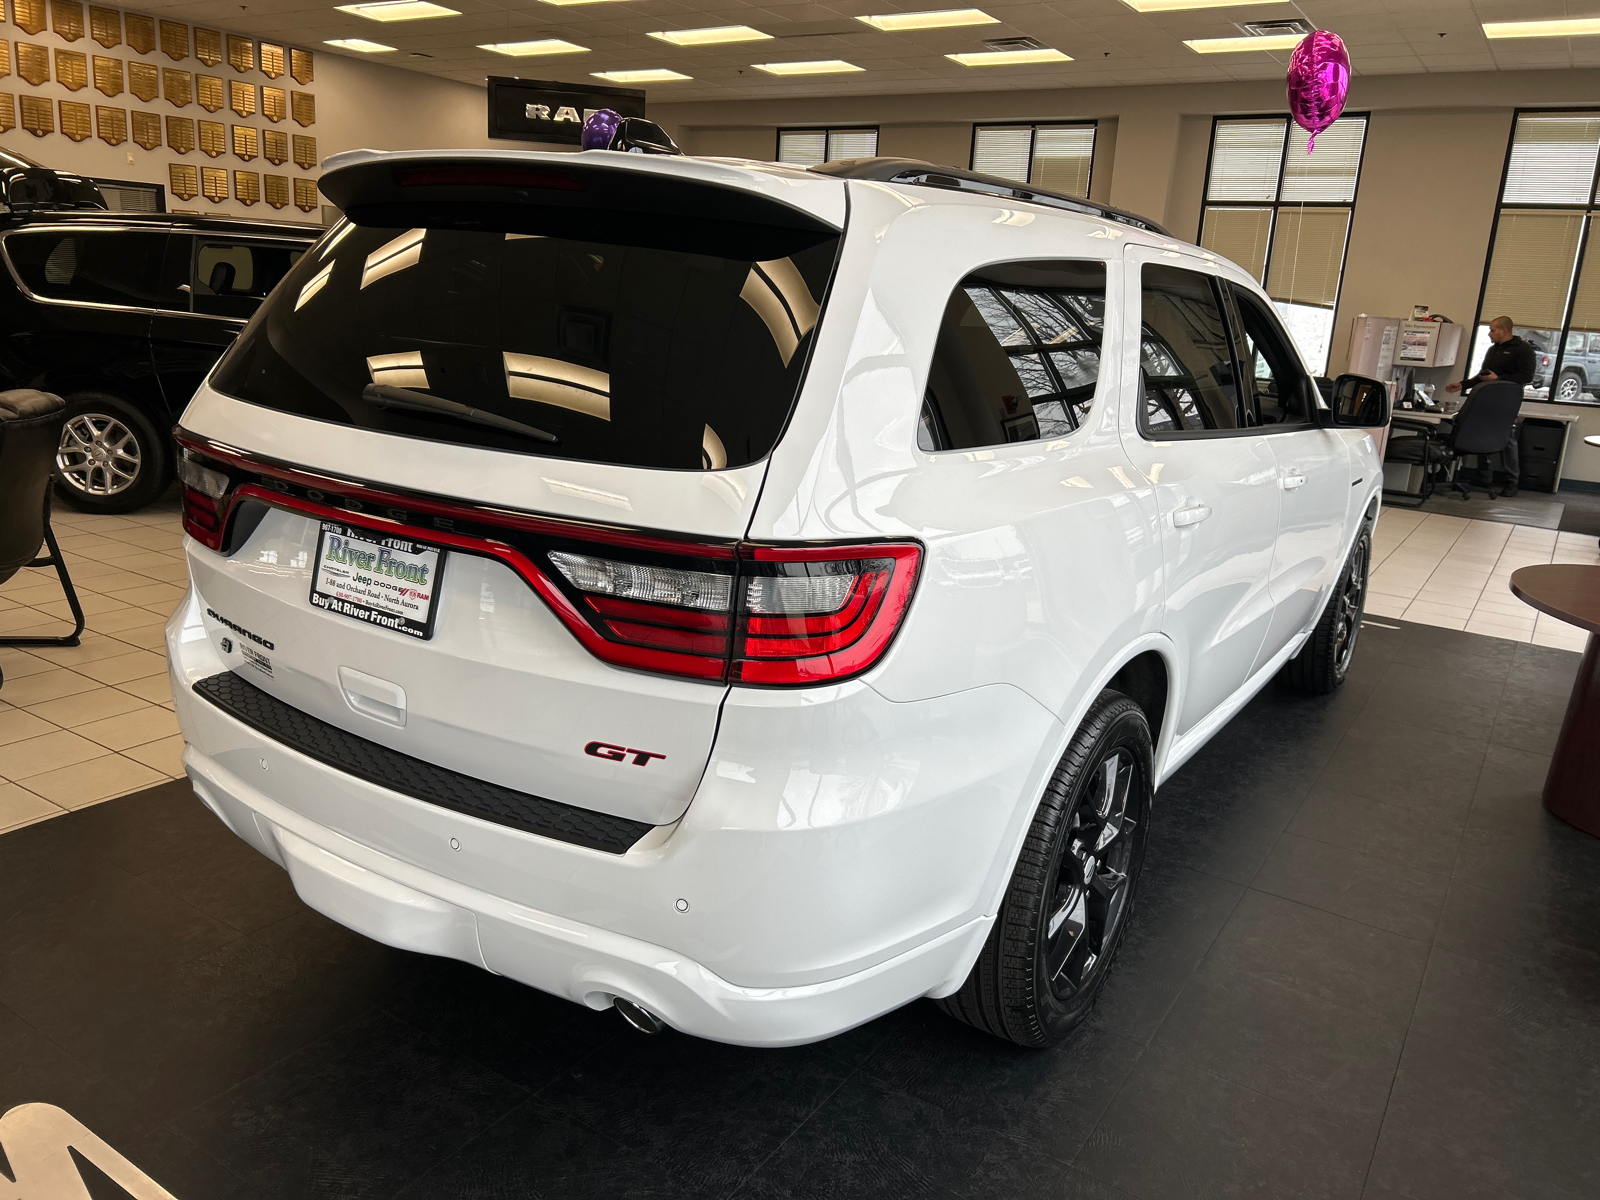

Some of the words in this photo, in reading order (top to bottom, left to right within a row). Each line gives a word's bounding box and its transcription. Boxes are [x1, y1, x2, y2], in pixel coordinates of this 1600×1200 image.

[274, 479, 454, 531] DODGE
[326, 535, 377, 571] River
[373, 547, 429, 586] Front
[336, 581, 346, 590] and
[346, 584, 366, 596] Orchard
[366, 589, 381, 600] Road
[383, 593, 400, 605] North
[400, 598, 420, 611] Aurora
[352, 572, 372, 587] Jeep
[374, 580, 404, 593] DODGE
[416, 592, 430, 601] RAM
[206, 607, 275, 651] DURANGO
[312, 592, 333, 609] Buy
[331, 598, 343, 612] At
[342, 602, 371, 620] River
[370, 610, 424, 637] Front.com
[584, 741, 667, 767] GT
